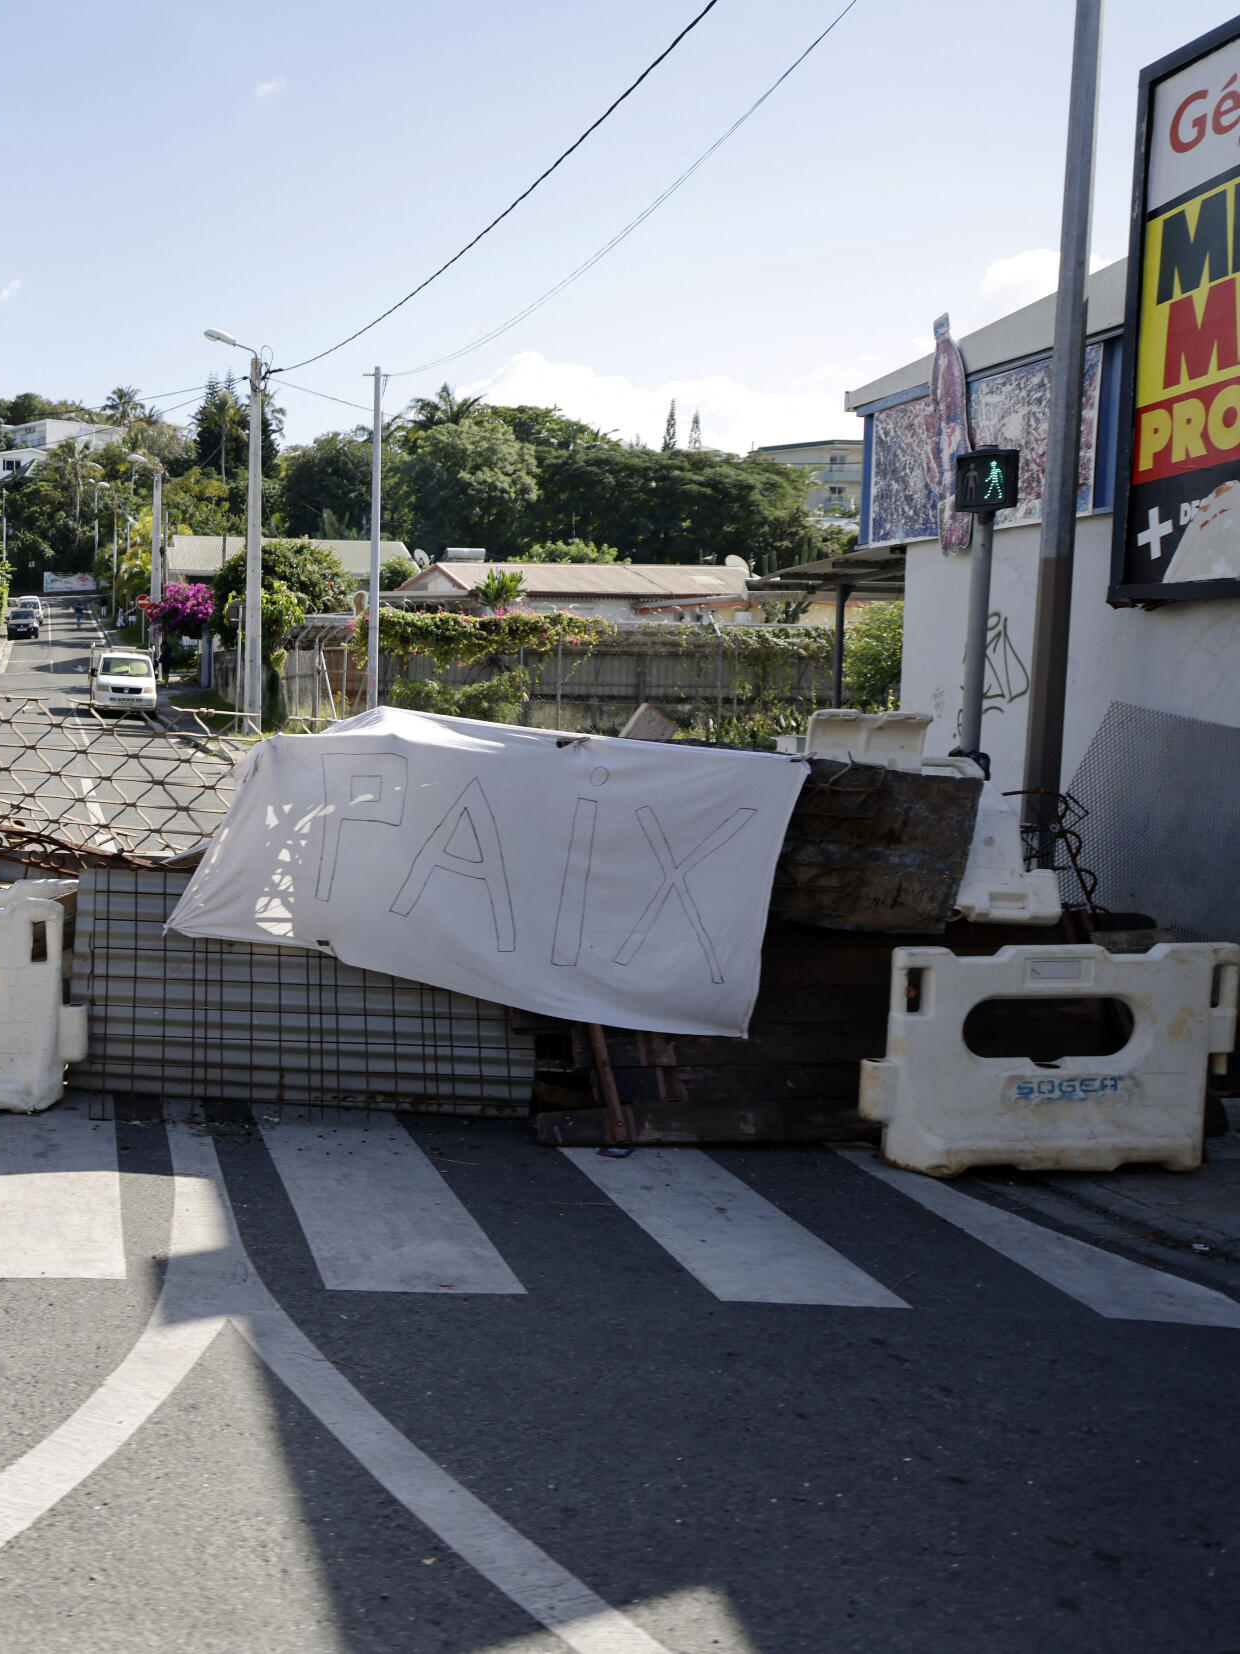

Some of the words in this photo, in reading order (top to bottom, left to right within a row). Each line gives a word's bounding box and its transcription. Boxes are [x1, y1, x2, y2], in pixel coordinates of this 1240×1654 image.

[1157, 182, 1240, 306] M
[1139, 384, 1240, 472] PRO
[1016, 1077, 1118, 1096] SOGEA
